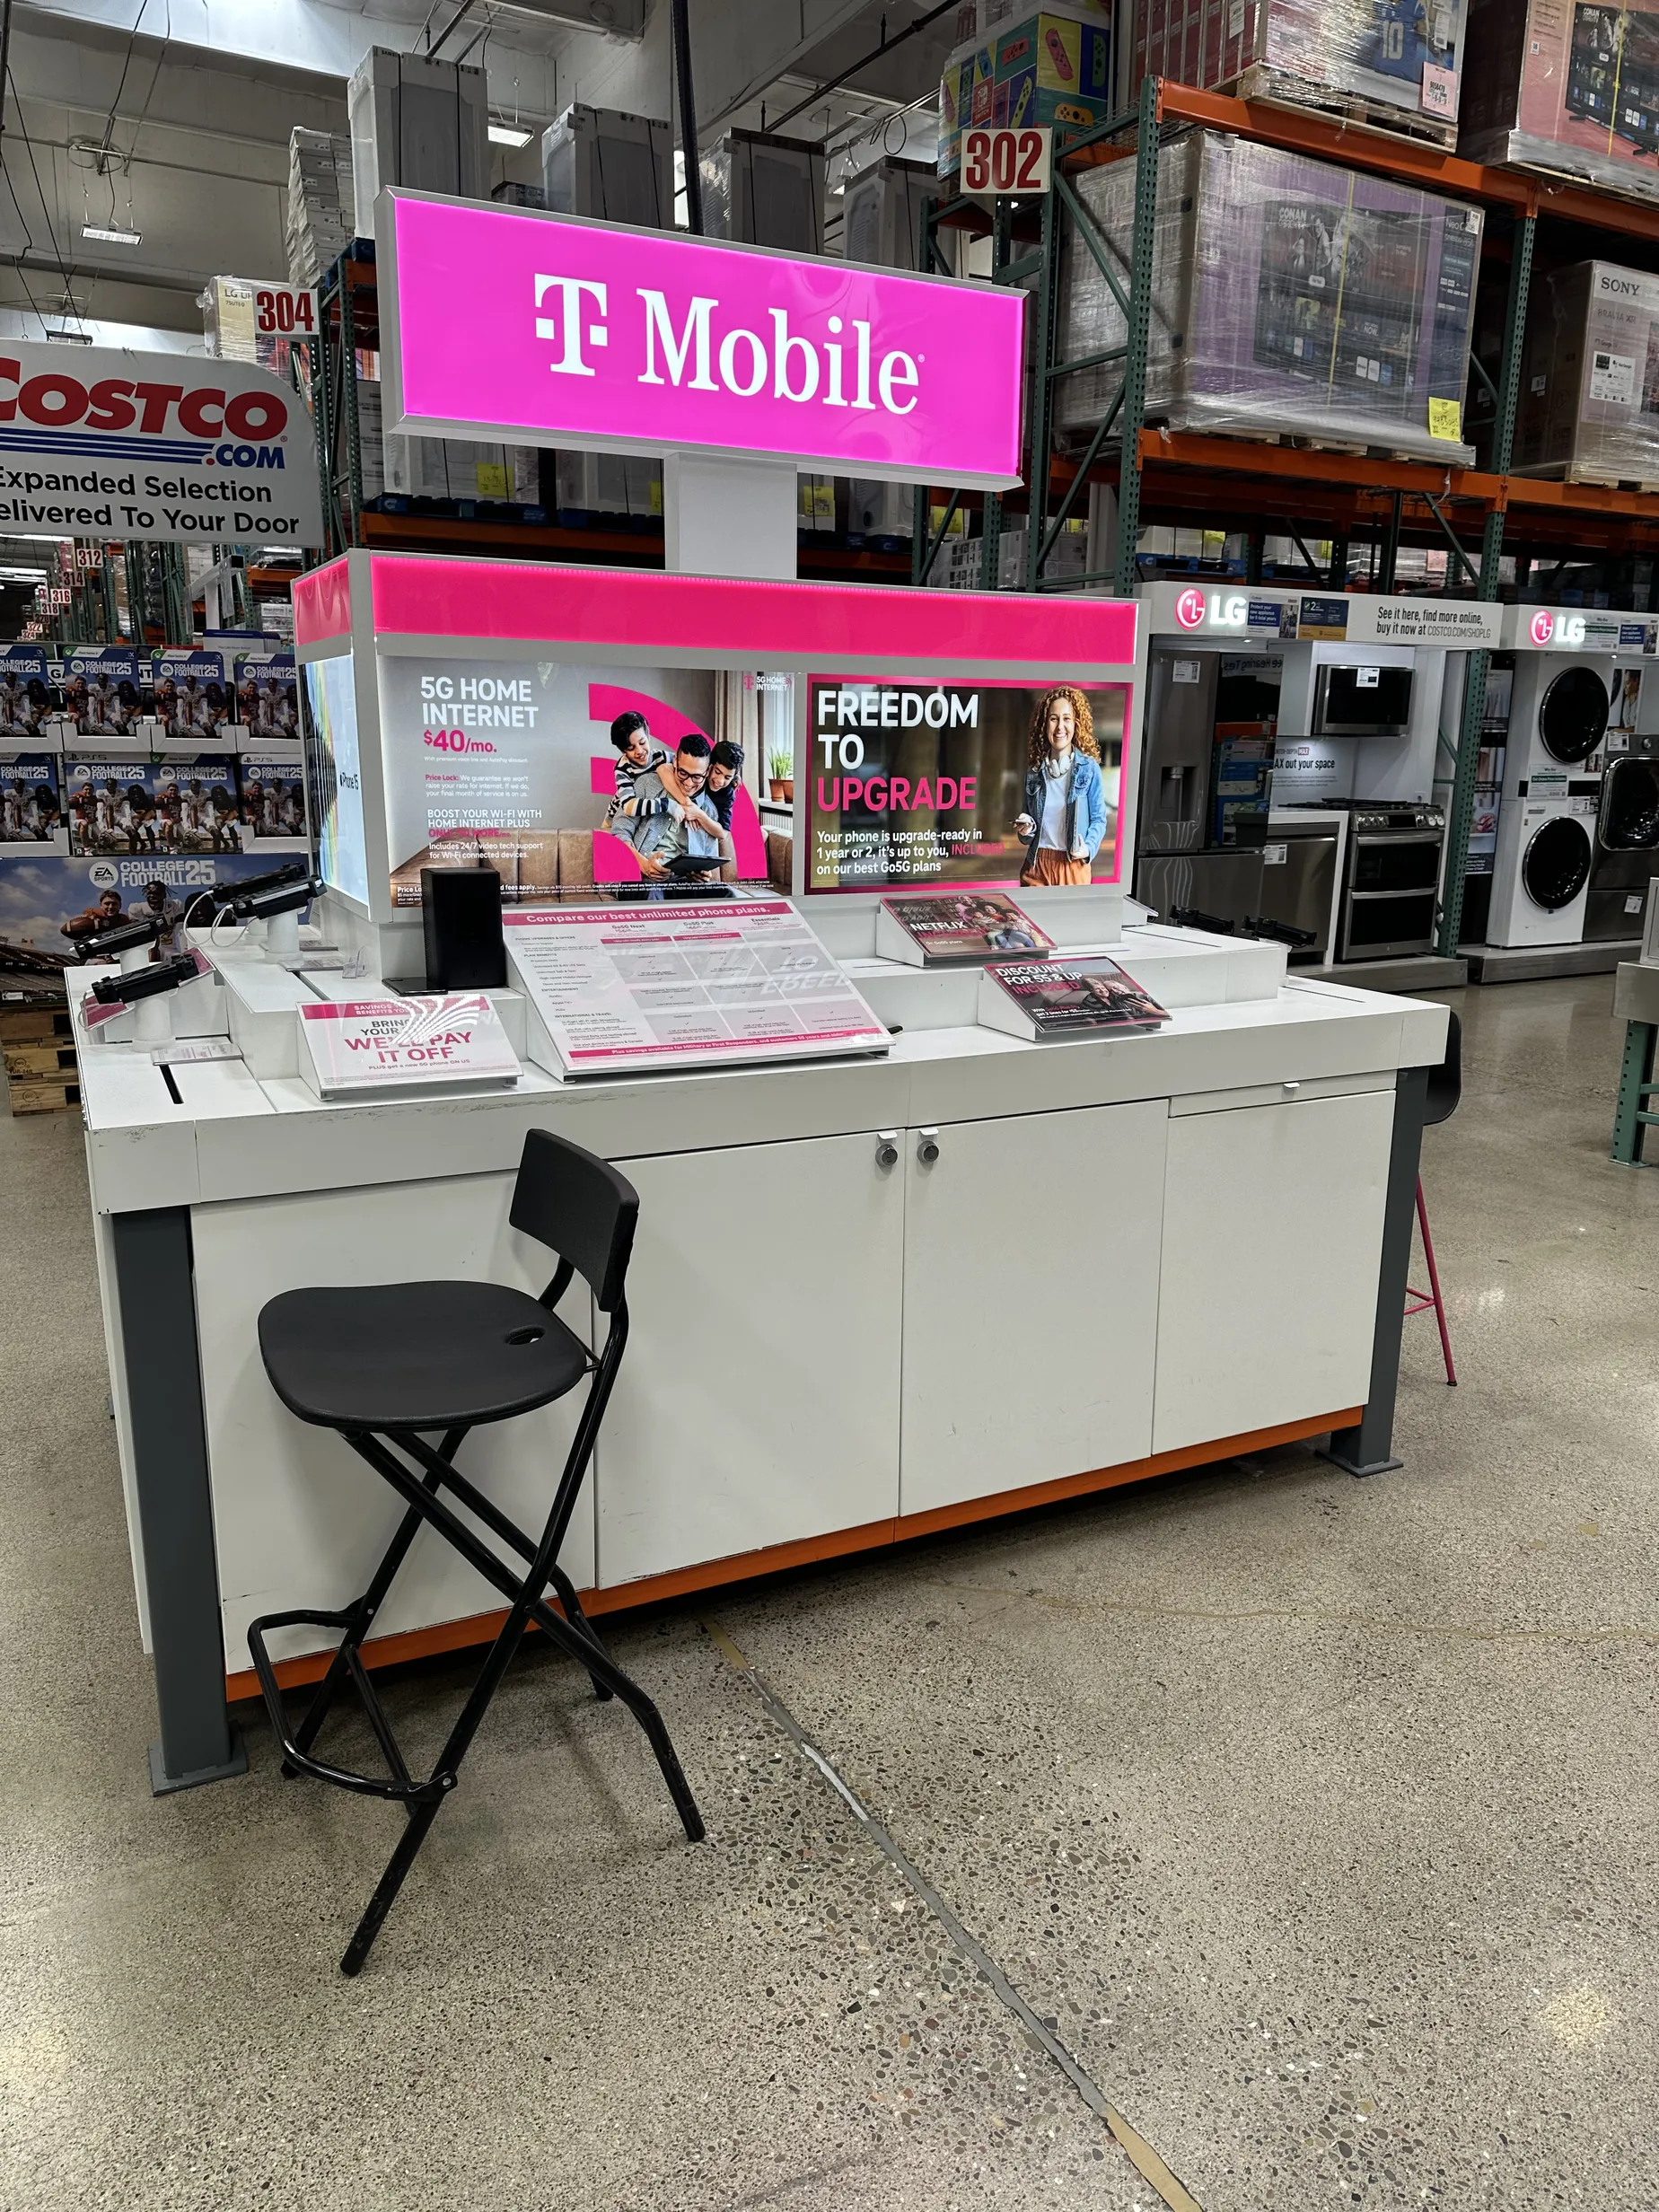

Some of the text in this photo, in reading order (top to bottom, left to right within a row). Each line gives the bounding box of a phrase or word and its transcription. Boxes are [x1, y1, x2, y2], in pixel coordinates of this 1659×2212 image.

[1382, 21, 1404, 60] 10
[966, 131, 1042, 189] 302
[1279, 207, 1307, 222] CONAN
[224, 288, 238, 298] LG
[1601, 276, 1640, 296] SONY
[256, 291, 314, 332] 304
[1598, 308, 1624, 321] BRAVIA
[636, 287, 920, 415] Mobile
[206, 443, 285, 470] .COM
[145, 475, 272, 503] Selection
[0, 498, 300, 535] elivered To Your Door
[78, 549, 102, 566] 312
[63, 571, 84, 586] 314
[52, 590, 70, 602] 316
[41, 602, 58, 614] 318
[1209, 595, 1247, 626] LG
[1378, 607, 1483, 626] See it here, find more online,
[1376, 622, 1491, 638] buy it now at COSTCO.COM/SHOPLG
[1556, 616, 1586, 642] LG
[85, 660, 116, 668] COLLEGE
[85, 666, 117, 674] FOOTBALL
[115, 661, 132, 675] 25
[174, 663, 205, 671] COLLEGE
[174, 663, 219, 678] FOOTBALL 25
[756, 676, 766, 684] 5G
[766, 677, 786, 685] HOME
[756, 683, 788, 691] INTERNET
[420, 676, 532, 702] 5G HOME
[422, 703, 539, 728] INTERNET
[818, 689, 979, 728] FREEDOM
[423, 729, 497, 753] $40/mo.
[818, 733, 865, 769] TO
[1274, 758, 1336, 771] AX out your space
[92, 766, 145, 779] FOOTBALL 25
[471, 776, 503, 784] guarantee
[520, 783, 530, 791] do,
[817, 777, 977, 812] UPGRADE
[427, 809, 542, 819] BOOST YOUR WI-FI WITH
[427, 819, 531, 828] HOME INTERNET PLUS
[817, 828, 982, 847] Your phone is upgrade-ready in
[428, 841, 544, 852] Includes 24/7 video tech support
[816, 847, 822, 859] 1
[823, 848, 849, 861] year
[851, 848, 863, 858] or
[865, 847, 875, 860] 2,
[896, 848, 911, 860] up
[913, 847, 925, 857] to
[926, 847, 949, 859] you,
[952, 842, 1005, 856] INCLUDED
[429, 851, 530, 859] for Wi-Fi connected devices.
[94, 860, 186, 876] EA COLLEGE
[121, 870, 186, 888] FOOTBALL
[185, 859, 216, 885] 25
[816, 859, 942, 875] on our best Go5G plans
[526, 913, 584, 926] Compare
[610, 911, 636, 920] best
[639, 908, 696, 919] unlimited
[698, 907, 733, 917] phone
[737, 906, 771, 916] plans.
[909, 921, 968, 931] NETFLIX
[996, 963, 1066, 978] DISCOUNT
[1004, 971, 1083, 986] FOR 55 & UP
[1012, 981, 1082, 996] INCLUDED
[354, 1003, 392, 1011] SAVINGS
[361, 1027, 399, 1036] YOUR
[429, 1031, 472, 1046] PAY
[377, 1046, 454, 1063] IT OFF
